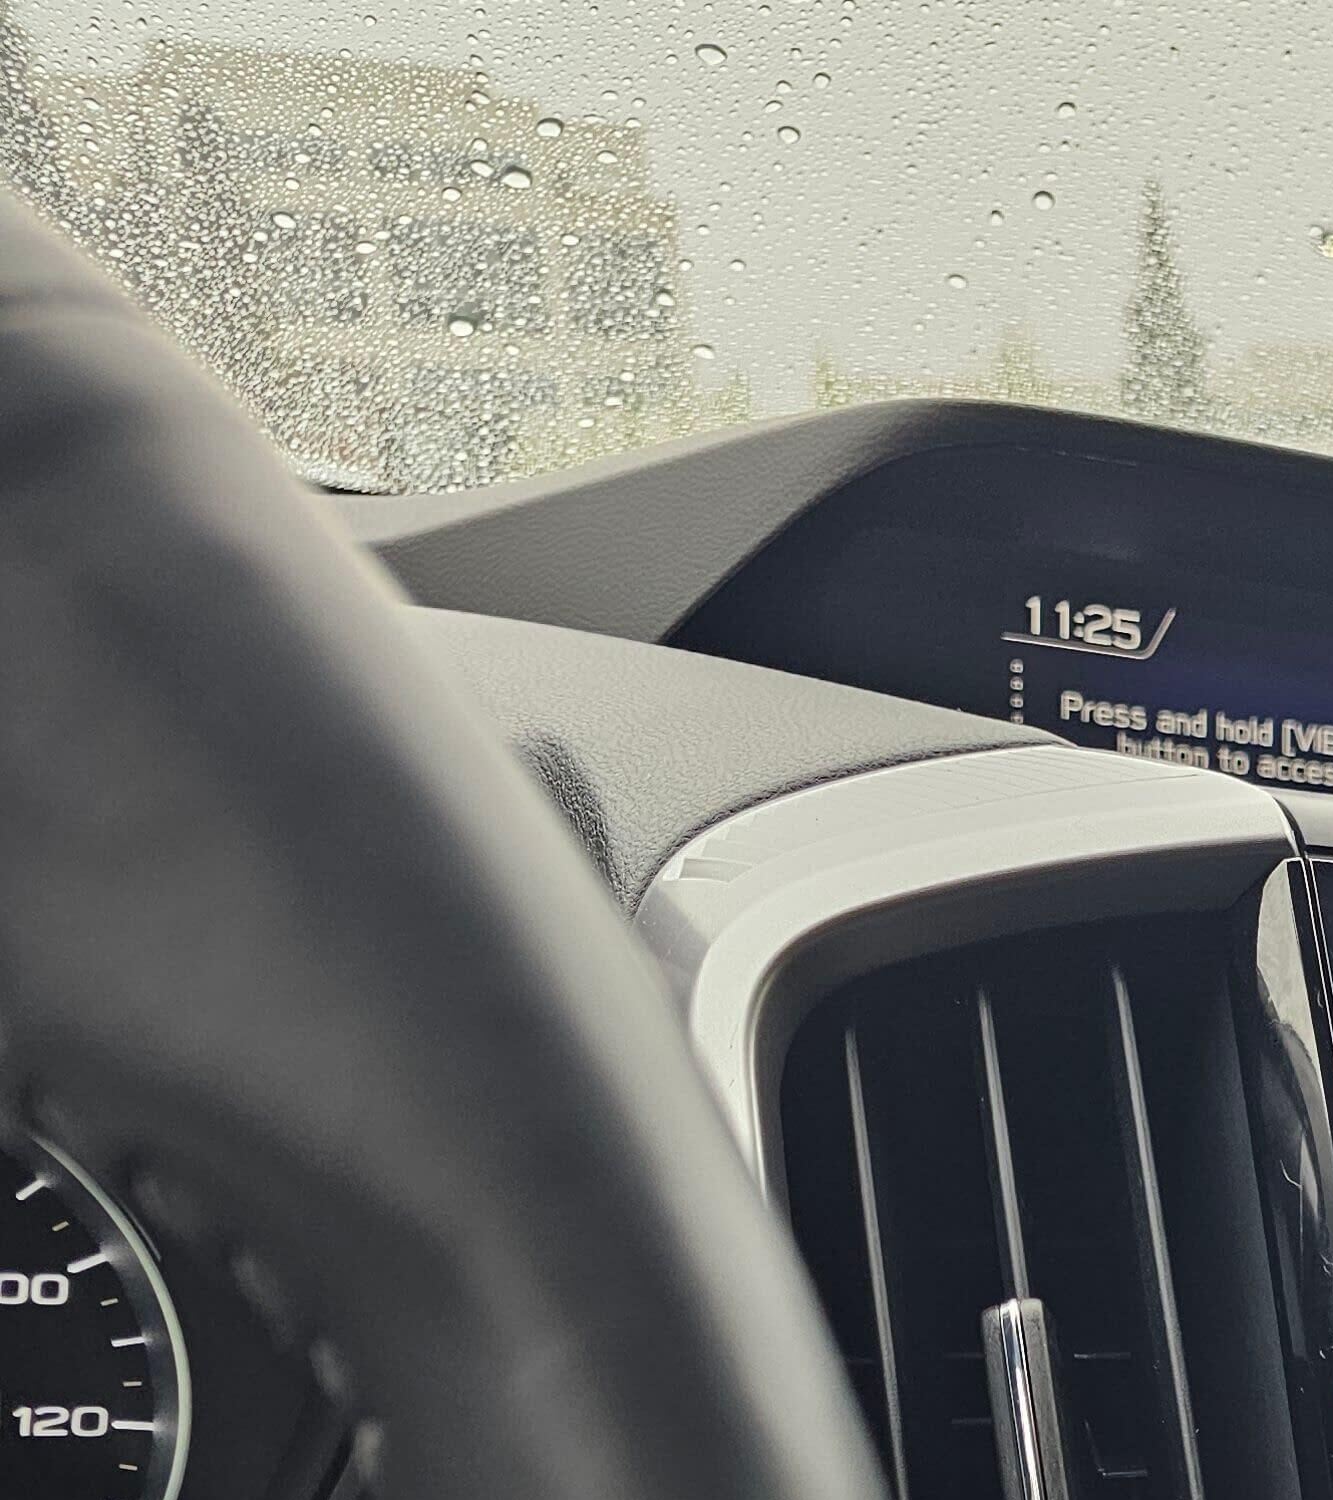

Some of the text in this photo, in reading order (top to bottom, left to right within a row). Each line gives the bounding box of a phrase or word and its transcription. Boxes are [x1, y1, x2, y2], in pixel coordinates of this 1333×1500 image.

[1025, 596, 1141, 650] 11:25
[1060, 690, 1147, 731] Press
[1155, 709, 1208, 739] and
[1216, 712, 1273, 747] hold
[1116, 731, 1210, 769] button
[1217, 744, 1250, 775] to
[12, 1406, 110, 1437] 120
